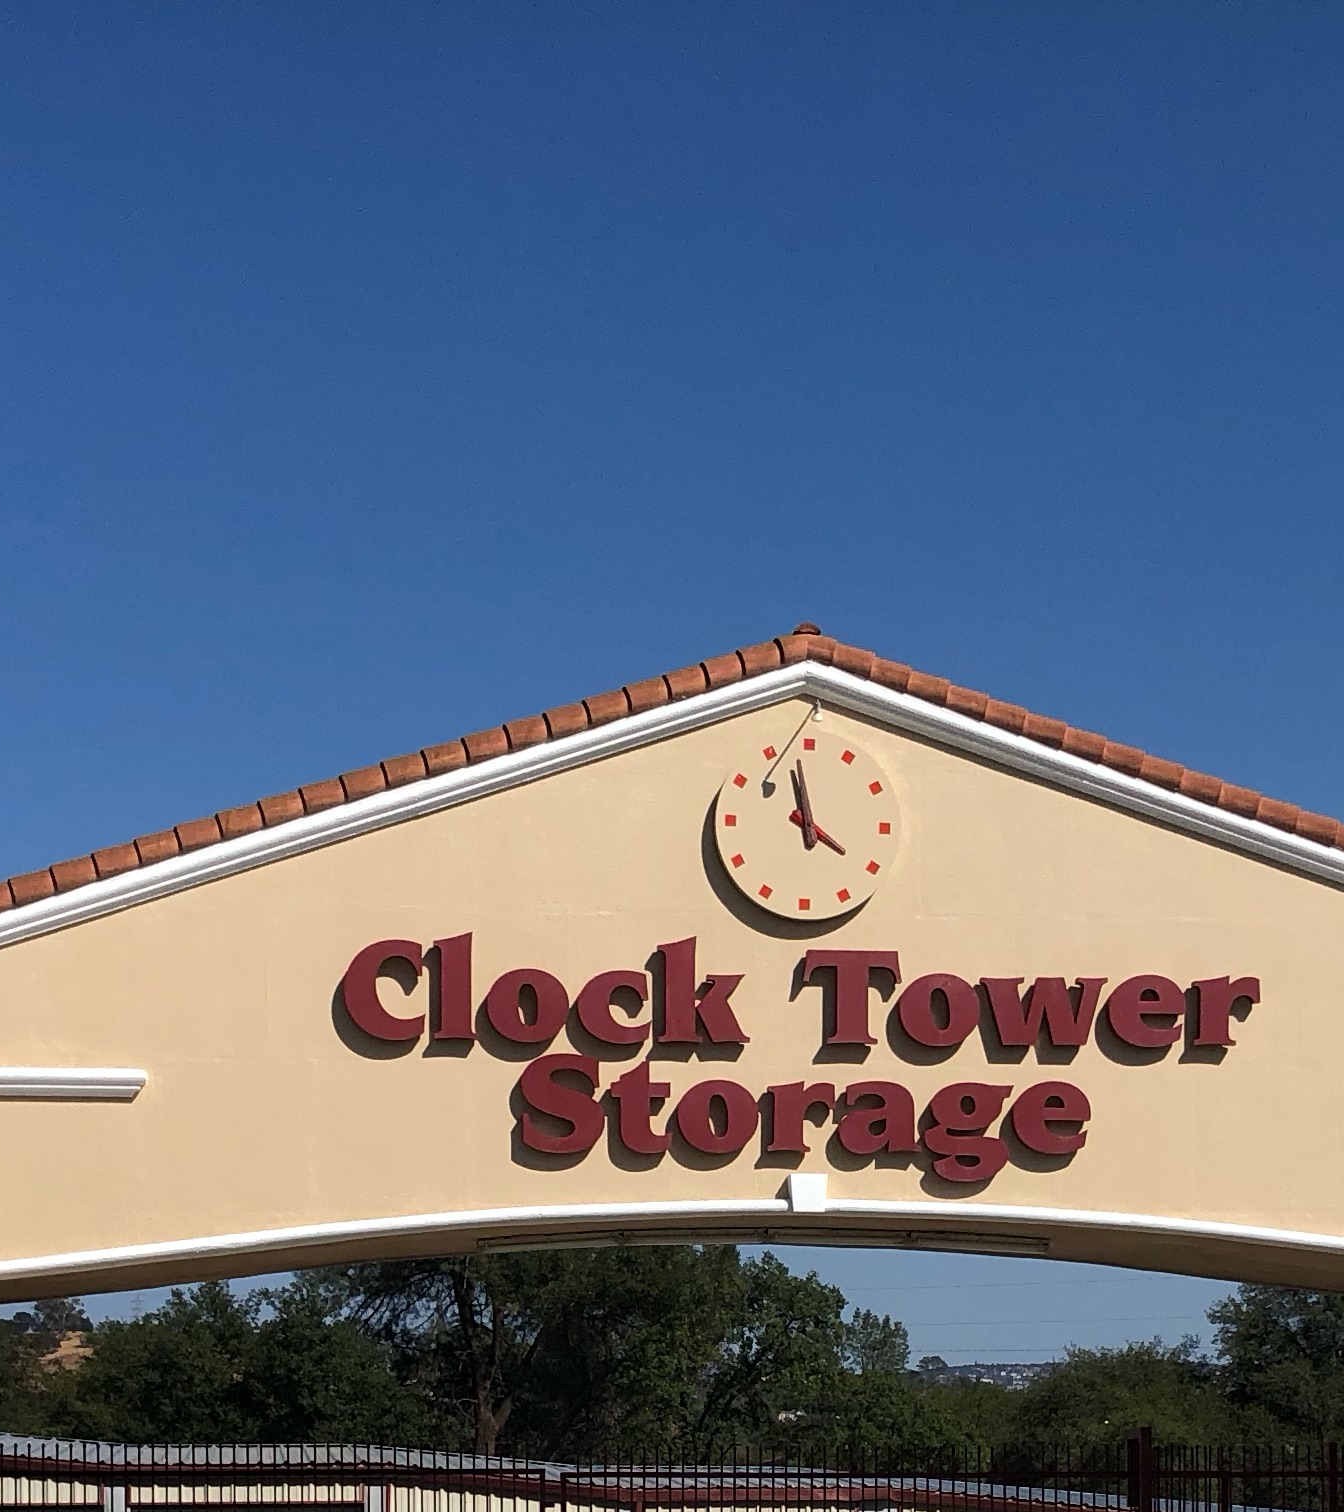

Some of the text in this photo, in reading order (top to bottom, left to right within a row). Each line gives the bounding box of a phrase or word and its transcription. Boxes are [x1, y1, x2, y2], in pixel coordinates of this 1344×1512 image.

[342, 931, 1261, 1048] Clock Tower
[519, 1053, 1092, 1183] Storage
